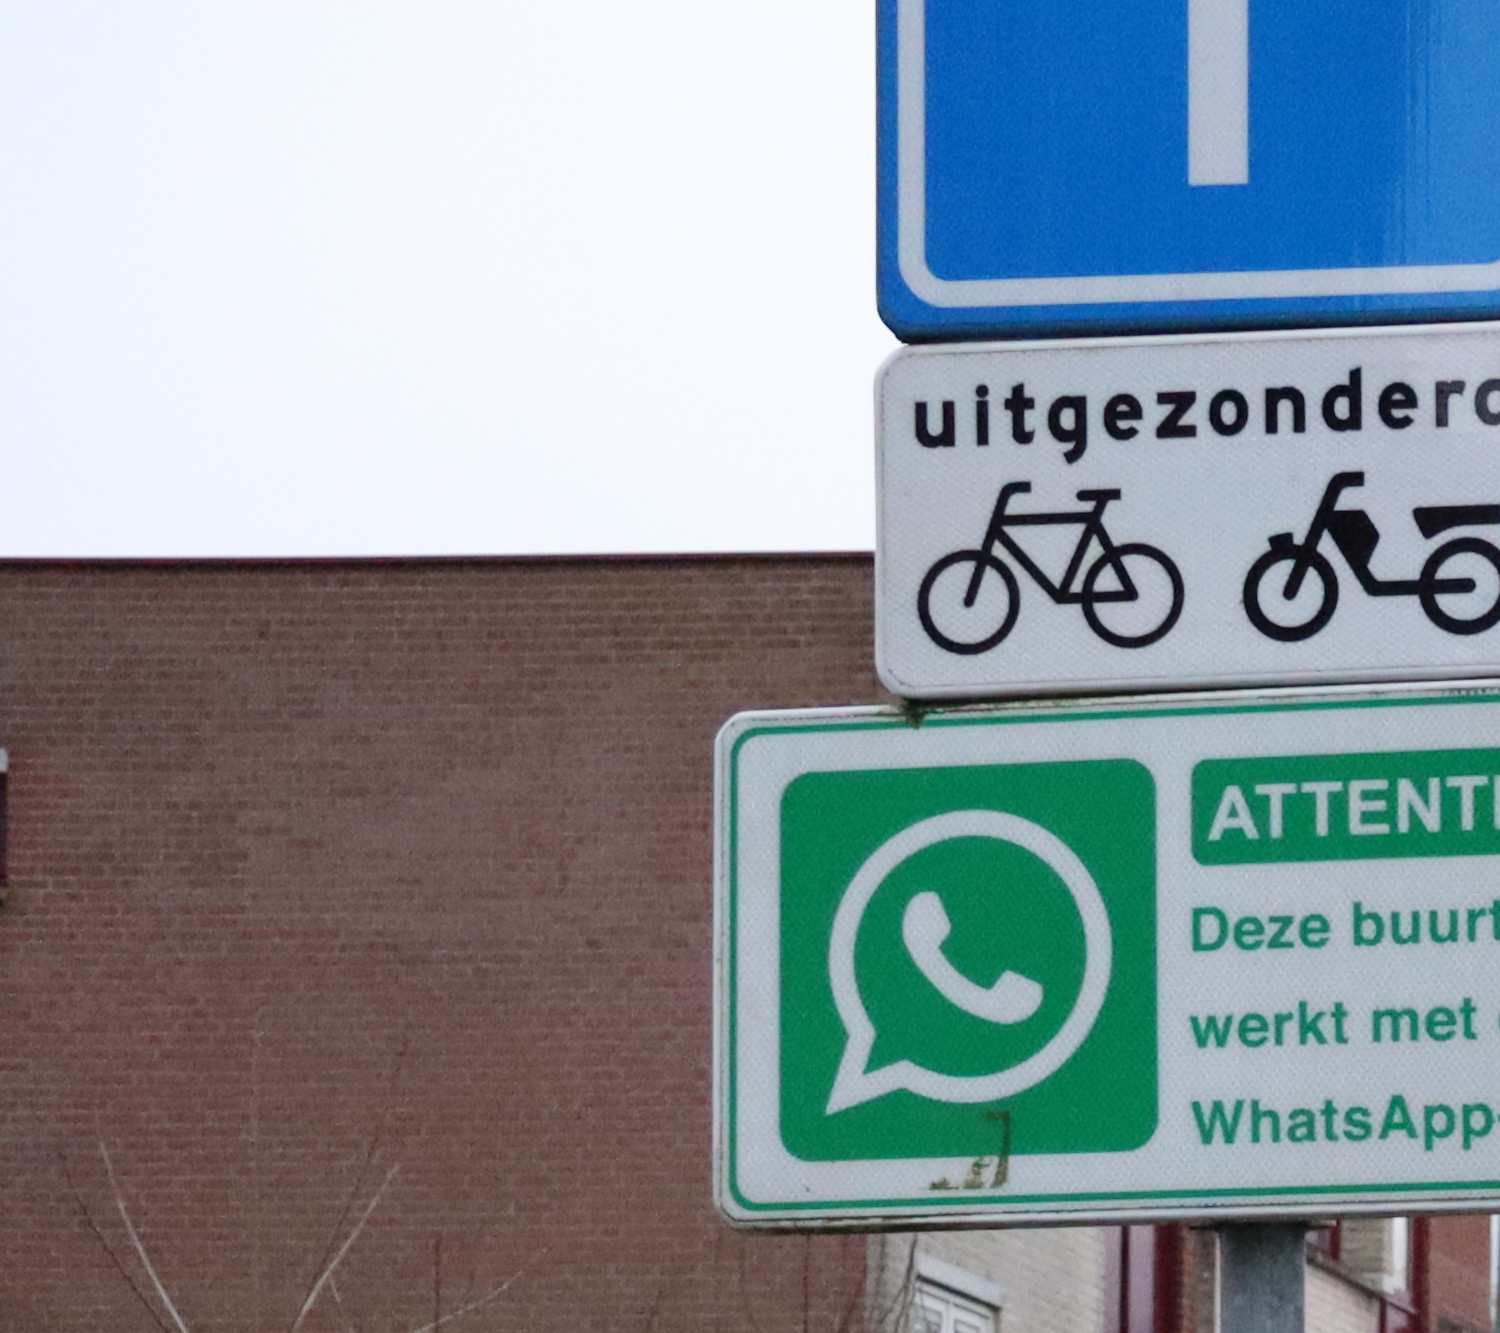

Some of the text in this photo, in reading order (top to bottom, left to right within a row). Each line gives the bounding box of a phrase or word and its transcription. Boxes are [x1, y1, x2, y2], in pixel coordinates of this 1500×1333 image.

[1190, 903, 1331, 953] Deze
[1189, 1001, 1349, 1049] werkt
[1370, 997, 1478, 1043] met
